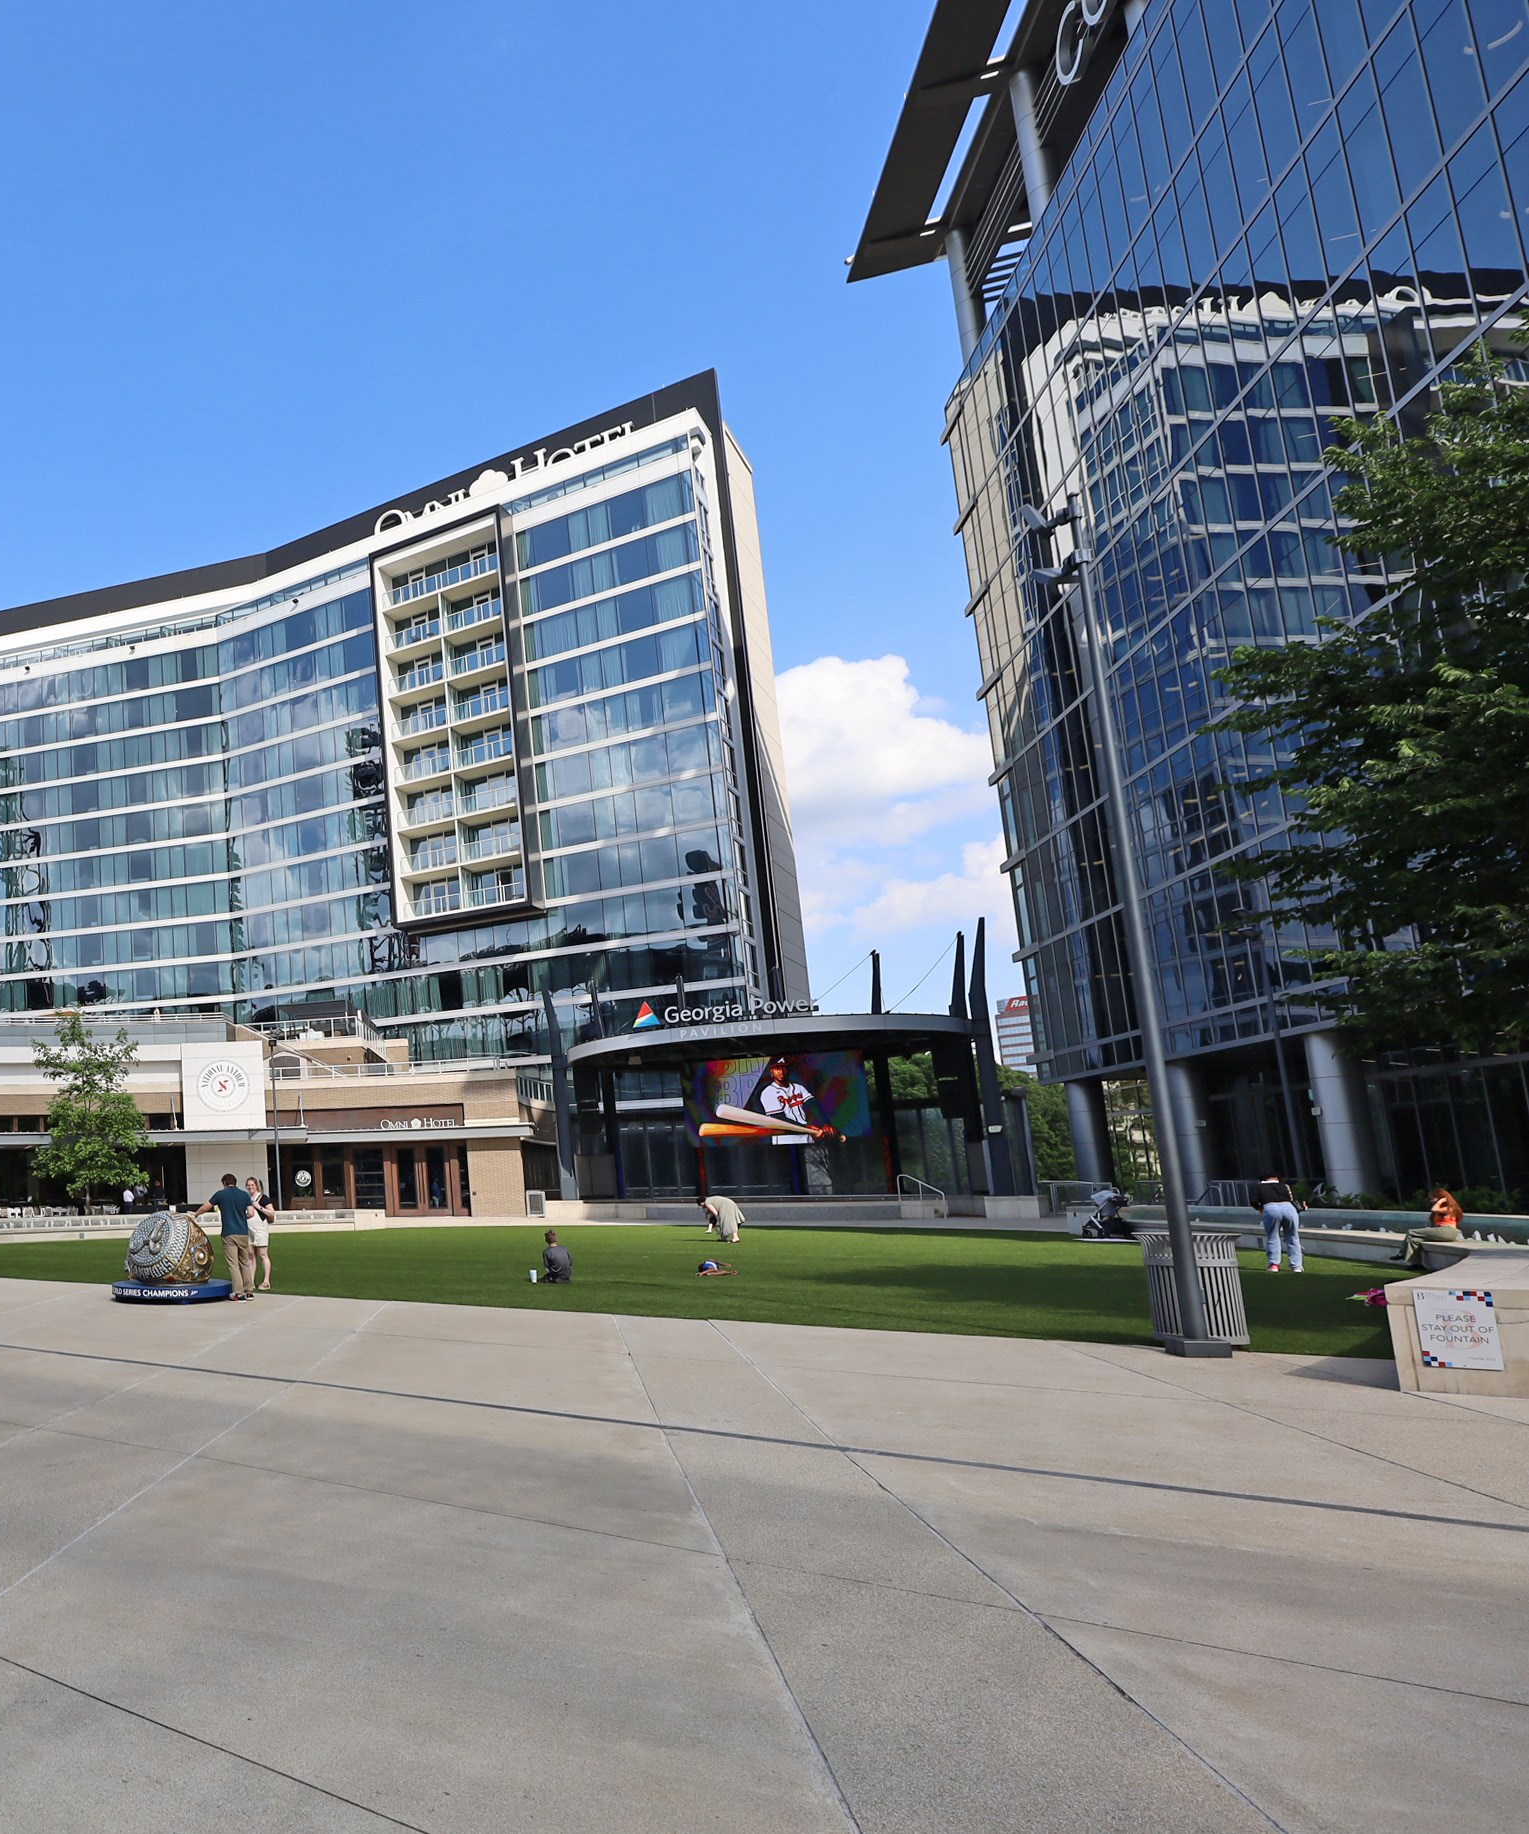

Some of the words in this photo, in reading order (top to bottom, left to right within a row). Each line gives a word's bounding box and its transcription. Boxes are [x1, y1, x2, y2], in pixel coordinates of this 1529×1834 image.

[663, 1000, 743, 1024] Georgia
[750, 995, 816, 1015] Power
[679, 1022, 763, 1039] PAVILION
[423, 1117, 456, 1128] HOTEL
[122, 1288, 142, 1297] SERIES
[142, 1288, 189, 1298] CHAMPIONS
[1435, 1313, 1477, 1323] PLEASE
[1421, 1324, 1448, 1332] STAY
[1450, 1324, 1474, 1333] OUT
[1477, 1326, 1494, 1334] OF
[1429, 1334, 1490, 1344] FOUNTAIN
